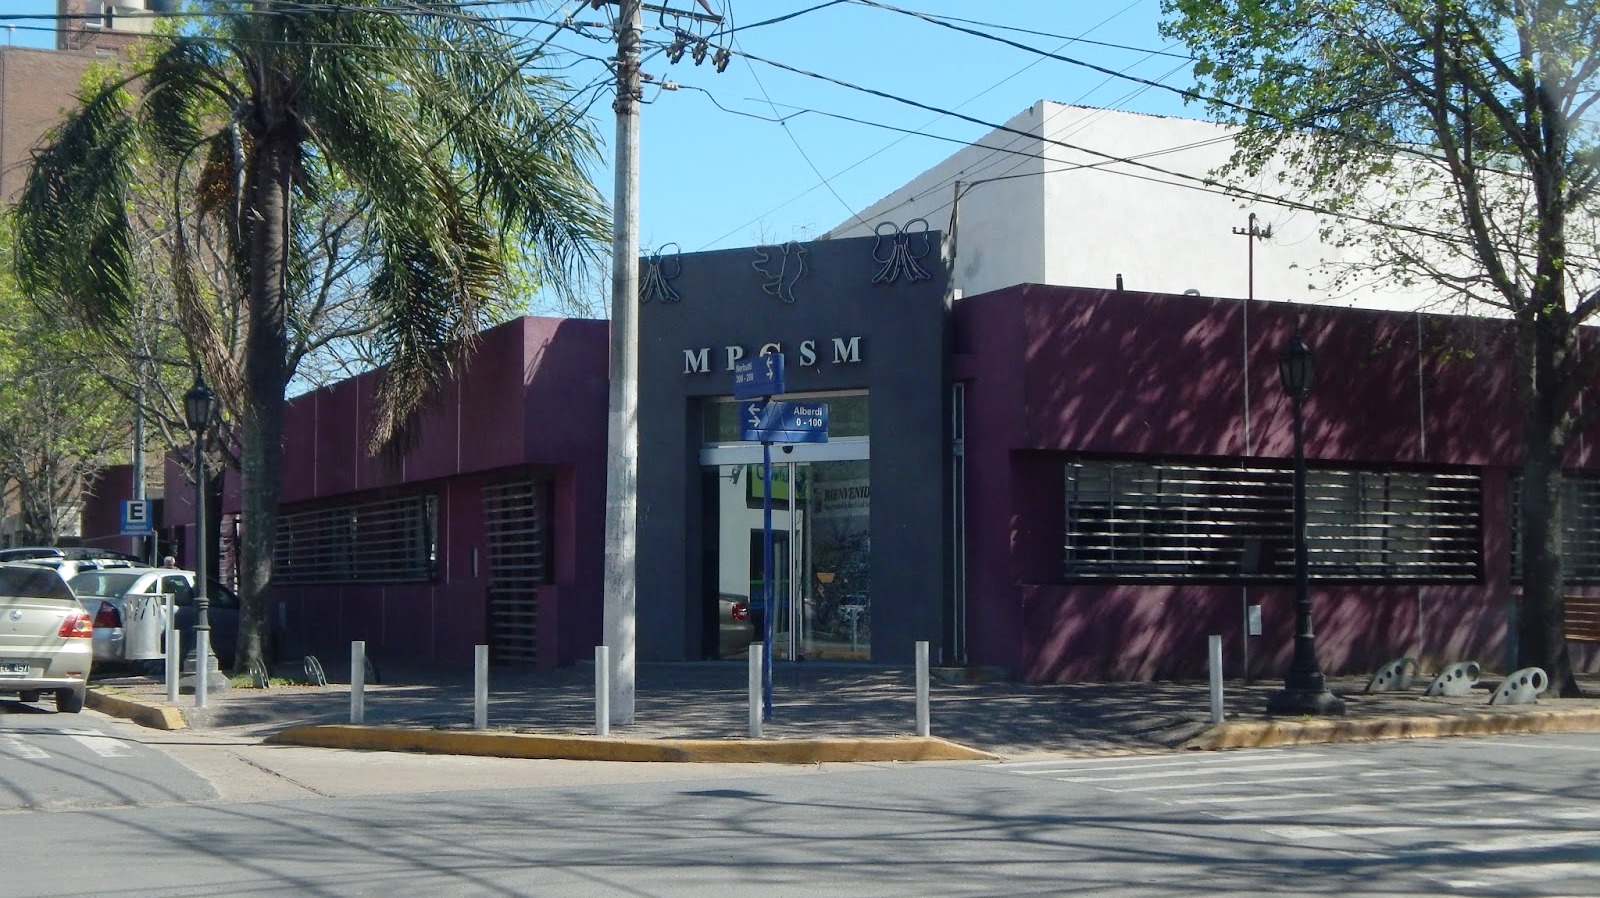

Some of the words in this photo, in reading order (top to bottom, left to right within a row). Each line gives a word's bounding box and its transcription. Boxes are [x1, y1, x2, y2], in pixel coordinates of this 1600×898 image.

[793, 406, 823, 416] Alberdi
[796, 418, 802, 427] 0
[808, 417, 823, 427] 100
[130, 503, 144, 520] E
